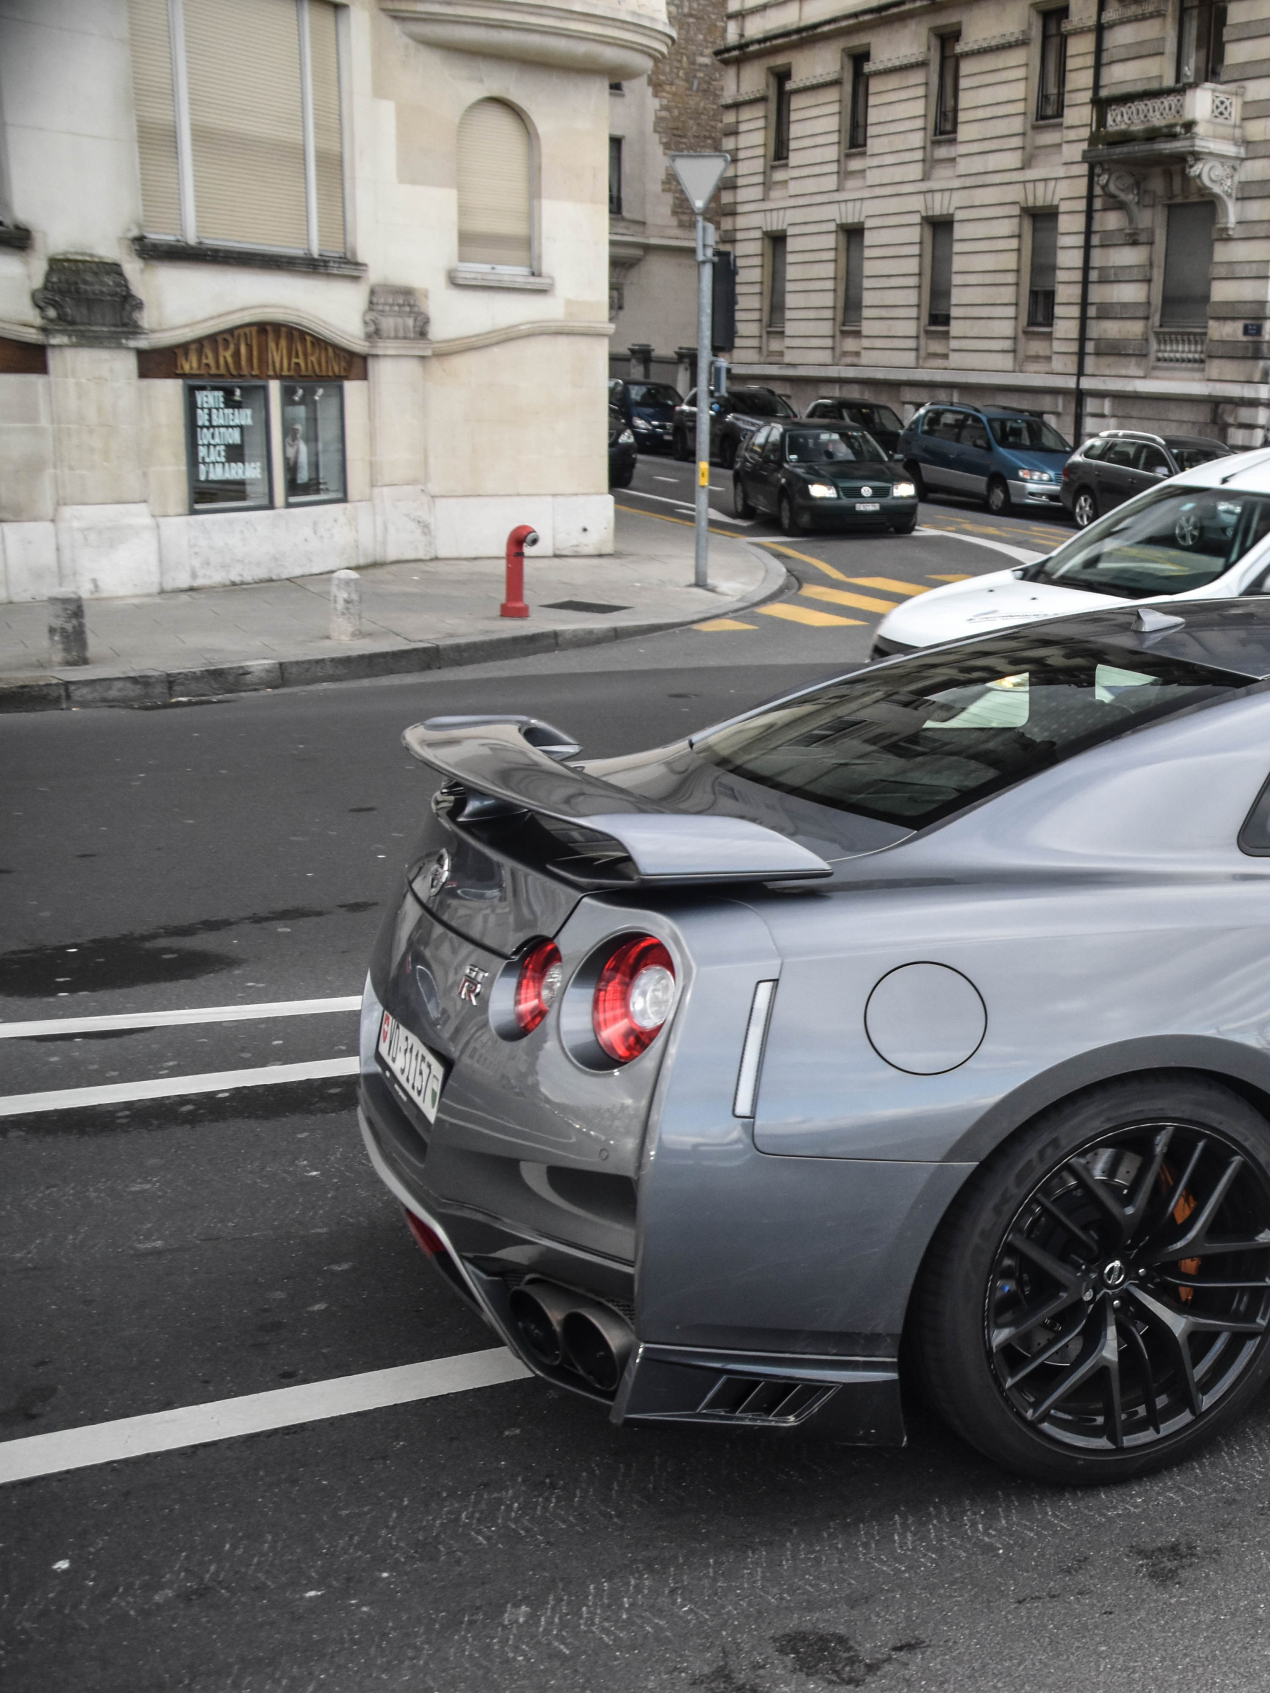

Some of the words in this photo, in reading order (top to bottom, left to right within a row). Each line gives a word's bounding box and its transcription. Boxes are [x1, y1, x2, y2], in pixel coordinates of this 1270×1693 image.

[175, 325, 260, 376] MARTI
[264, 324, 349, 377] MARINE
[195, 390, 225, 408] VENTE
[196, 408, 210, 426] DE
[211, 408, 253, 426] BATEAUX
[197, 427, 242, 445] LOCATION
[198, 445, 226, 463] PLACE
[199, 461, 262, 481] D'AMARRAGE
